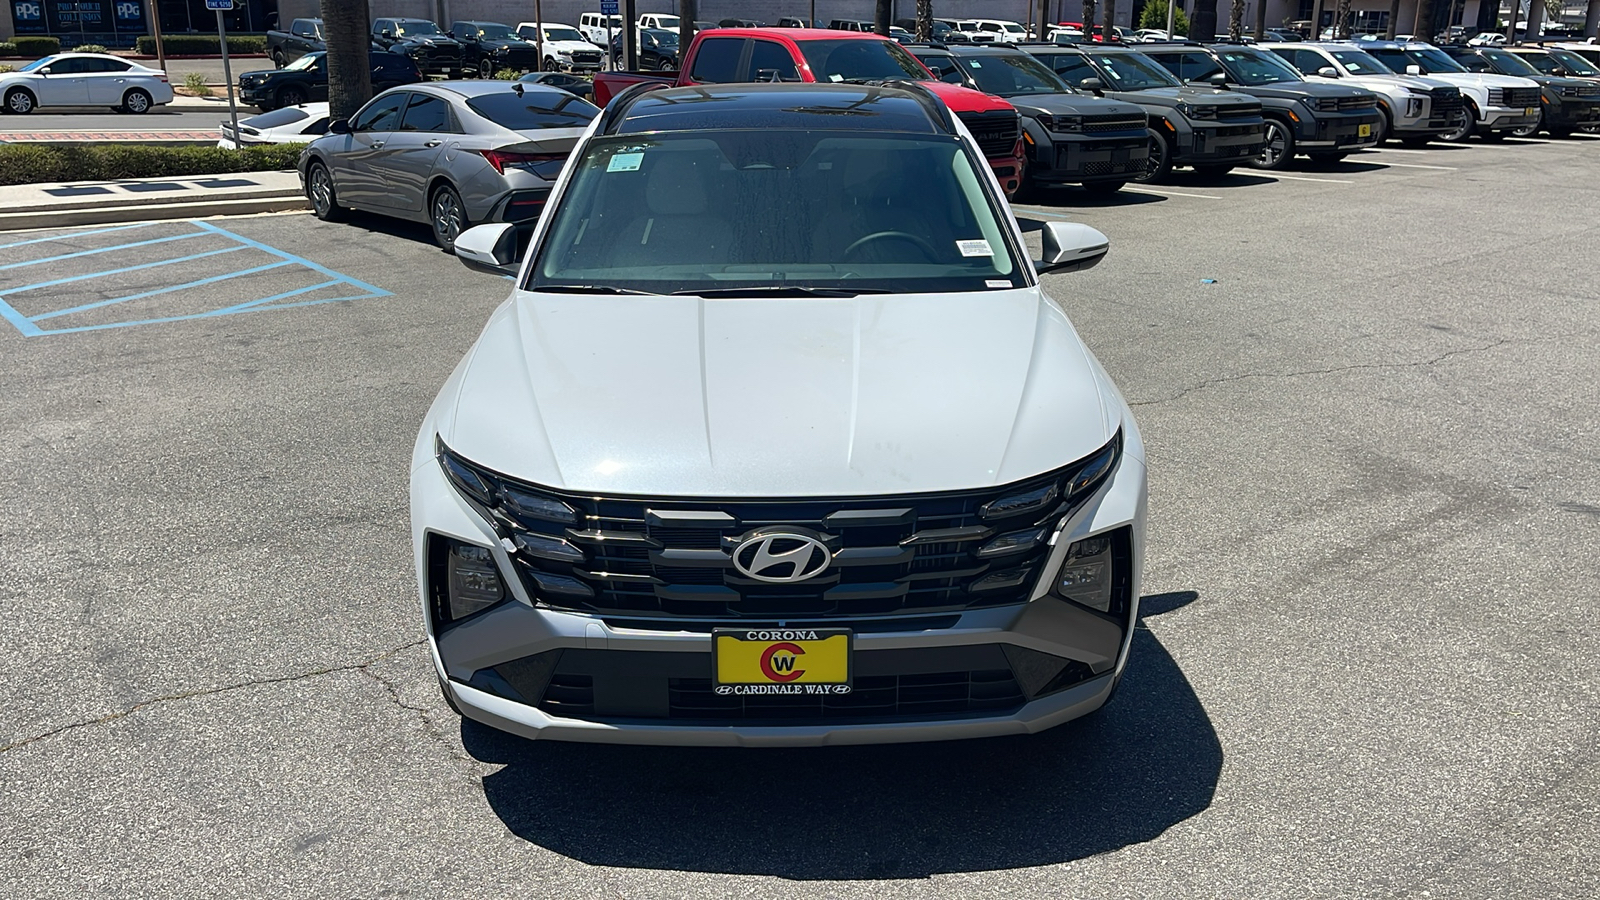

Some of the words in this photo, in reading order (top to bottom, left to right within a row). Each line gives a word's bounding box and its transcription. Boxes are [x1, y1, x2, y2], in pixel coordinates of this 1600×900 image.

[16, 3, 40, 18] PPG
[57, 3, 71, 11] PRO
[117, 2, 140, 18] PPG
[58, 13, 101, 21] COLLISION
[746, 630, 819, 641] CORONA
[734, 685, 803, 695] CARDINALE
[805, 685, 832, 694] WAY
